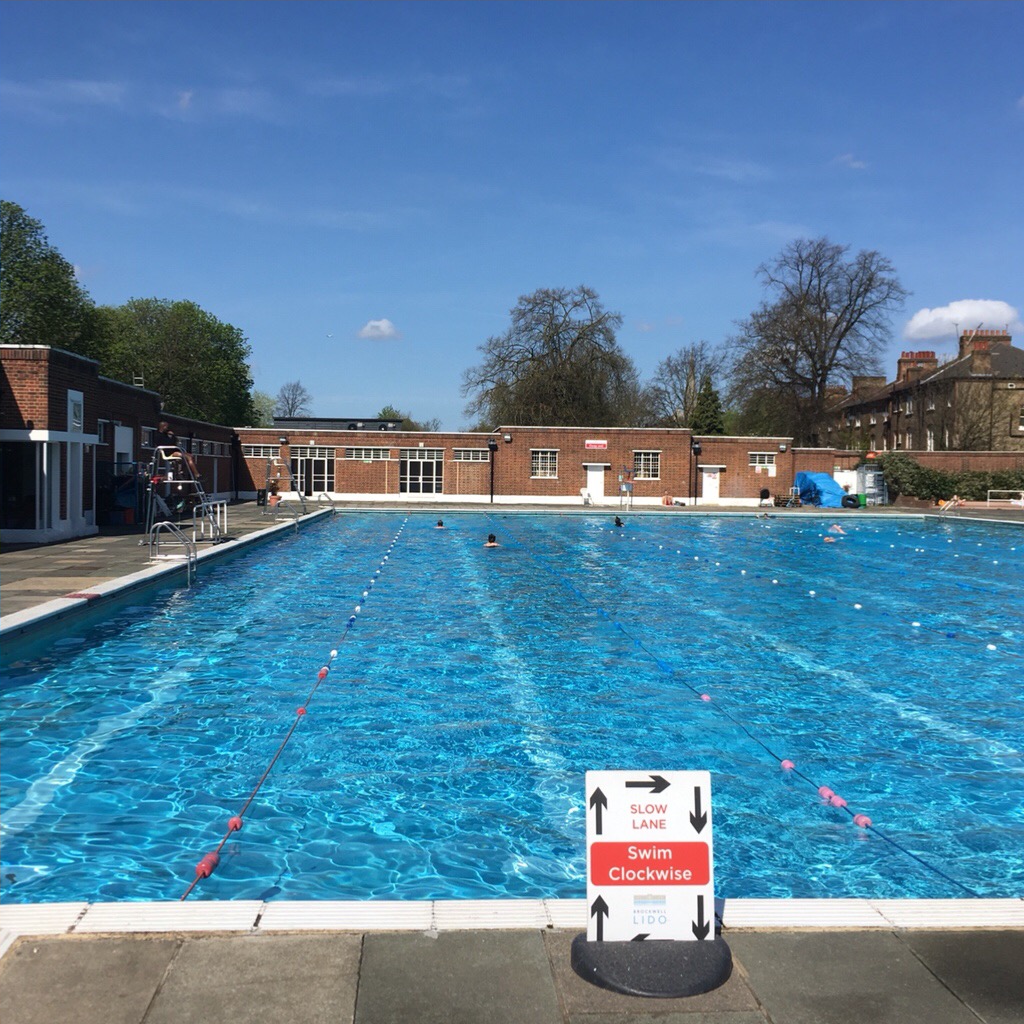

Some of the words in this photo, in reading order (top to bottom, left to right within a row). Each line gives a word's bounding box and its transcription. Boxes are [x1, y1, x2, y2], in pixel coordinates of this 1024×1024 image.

[630, 804, 668, 814] SLOW
[632, 819, 667, 829] LANE
[627, 845, 673, 860] Swim
[608, 866, 693, 881] Clockwise
[633, 915, 667, 925] LIDO
